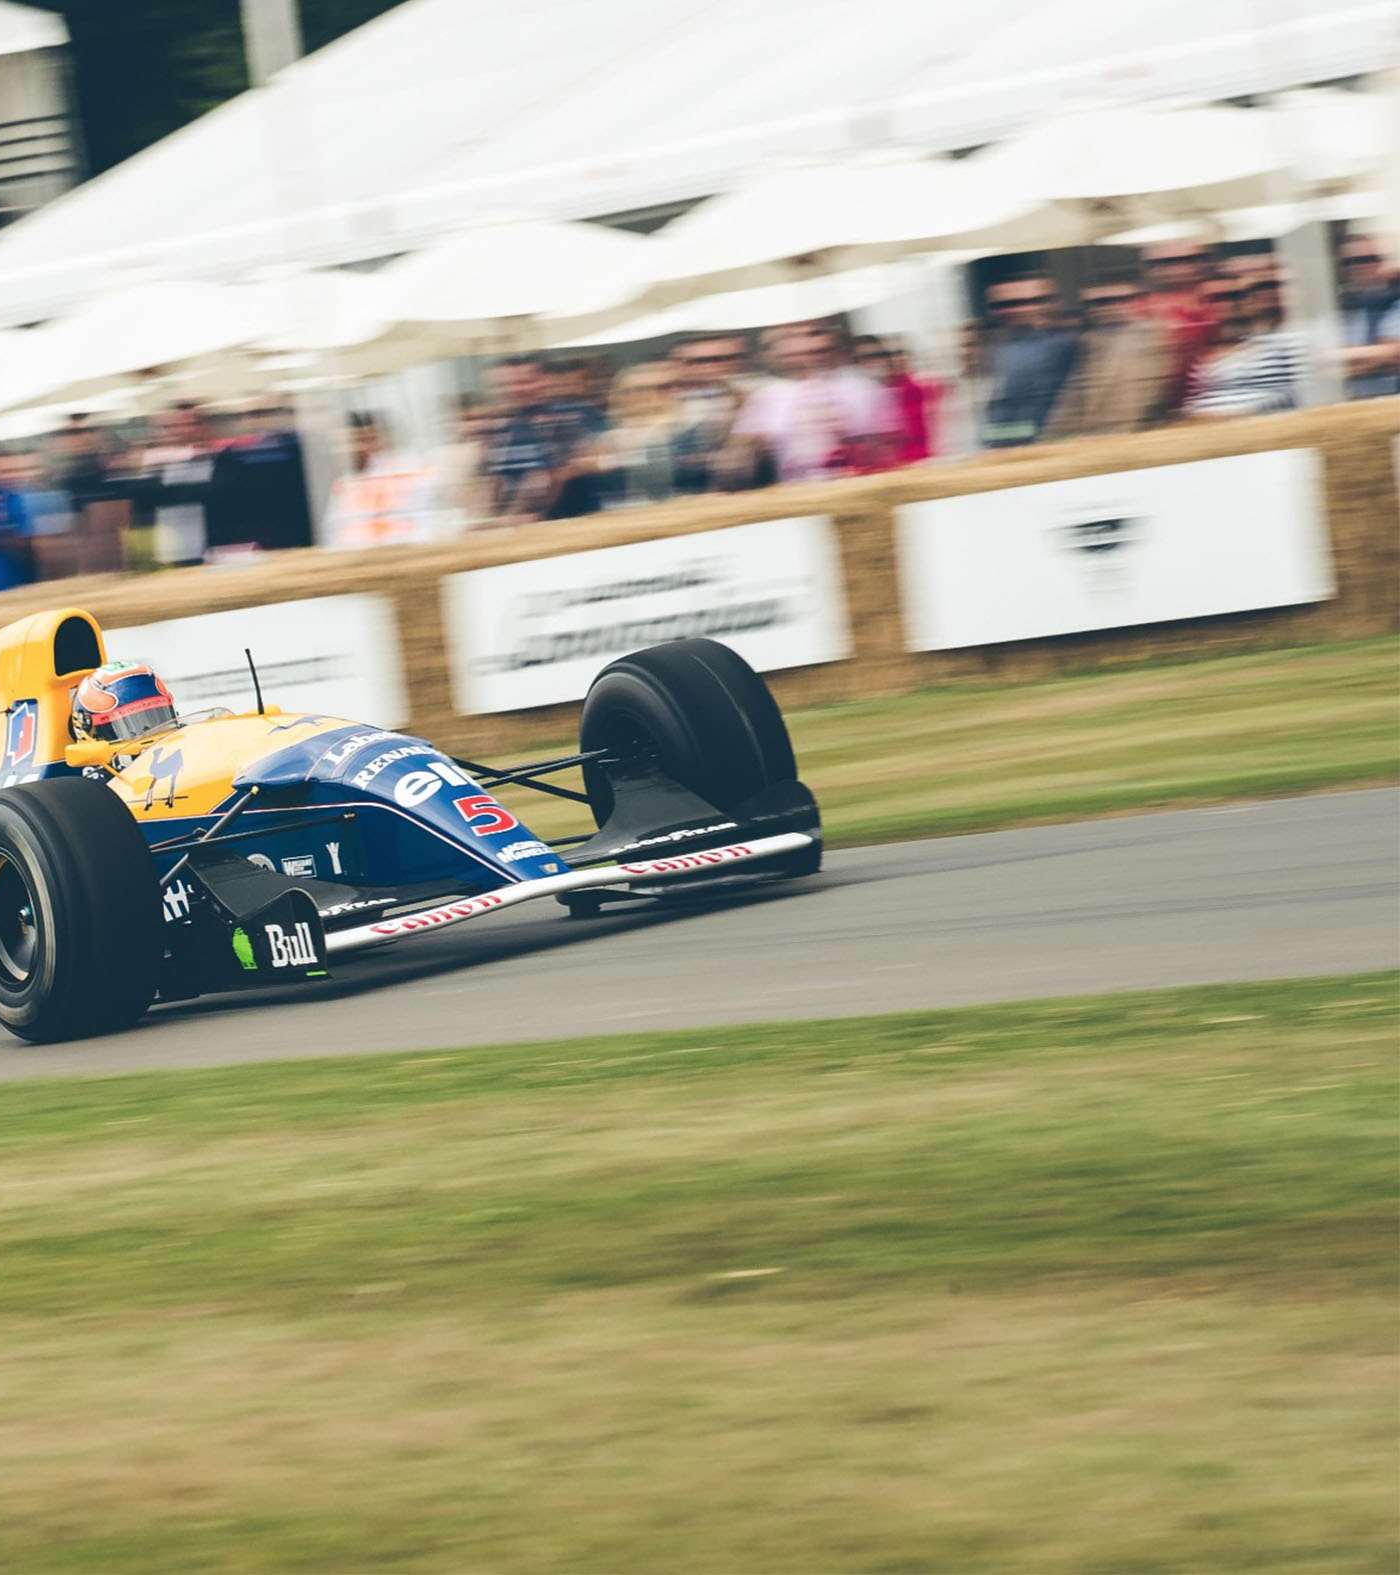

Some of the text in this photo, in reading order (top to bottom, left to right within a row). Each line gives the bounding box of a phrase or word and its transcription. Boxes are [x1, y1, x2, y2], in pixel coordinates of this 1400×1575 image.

[452, 794, 519, 837] 5
[620, 846, 753, 874] Canon
[369, 895, 502, 935] Canon
[264, 921, 319, 968] Bull
